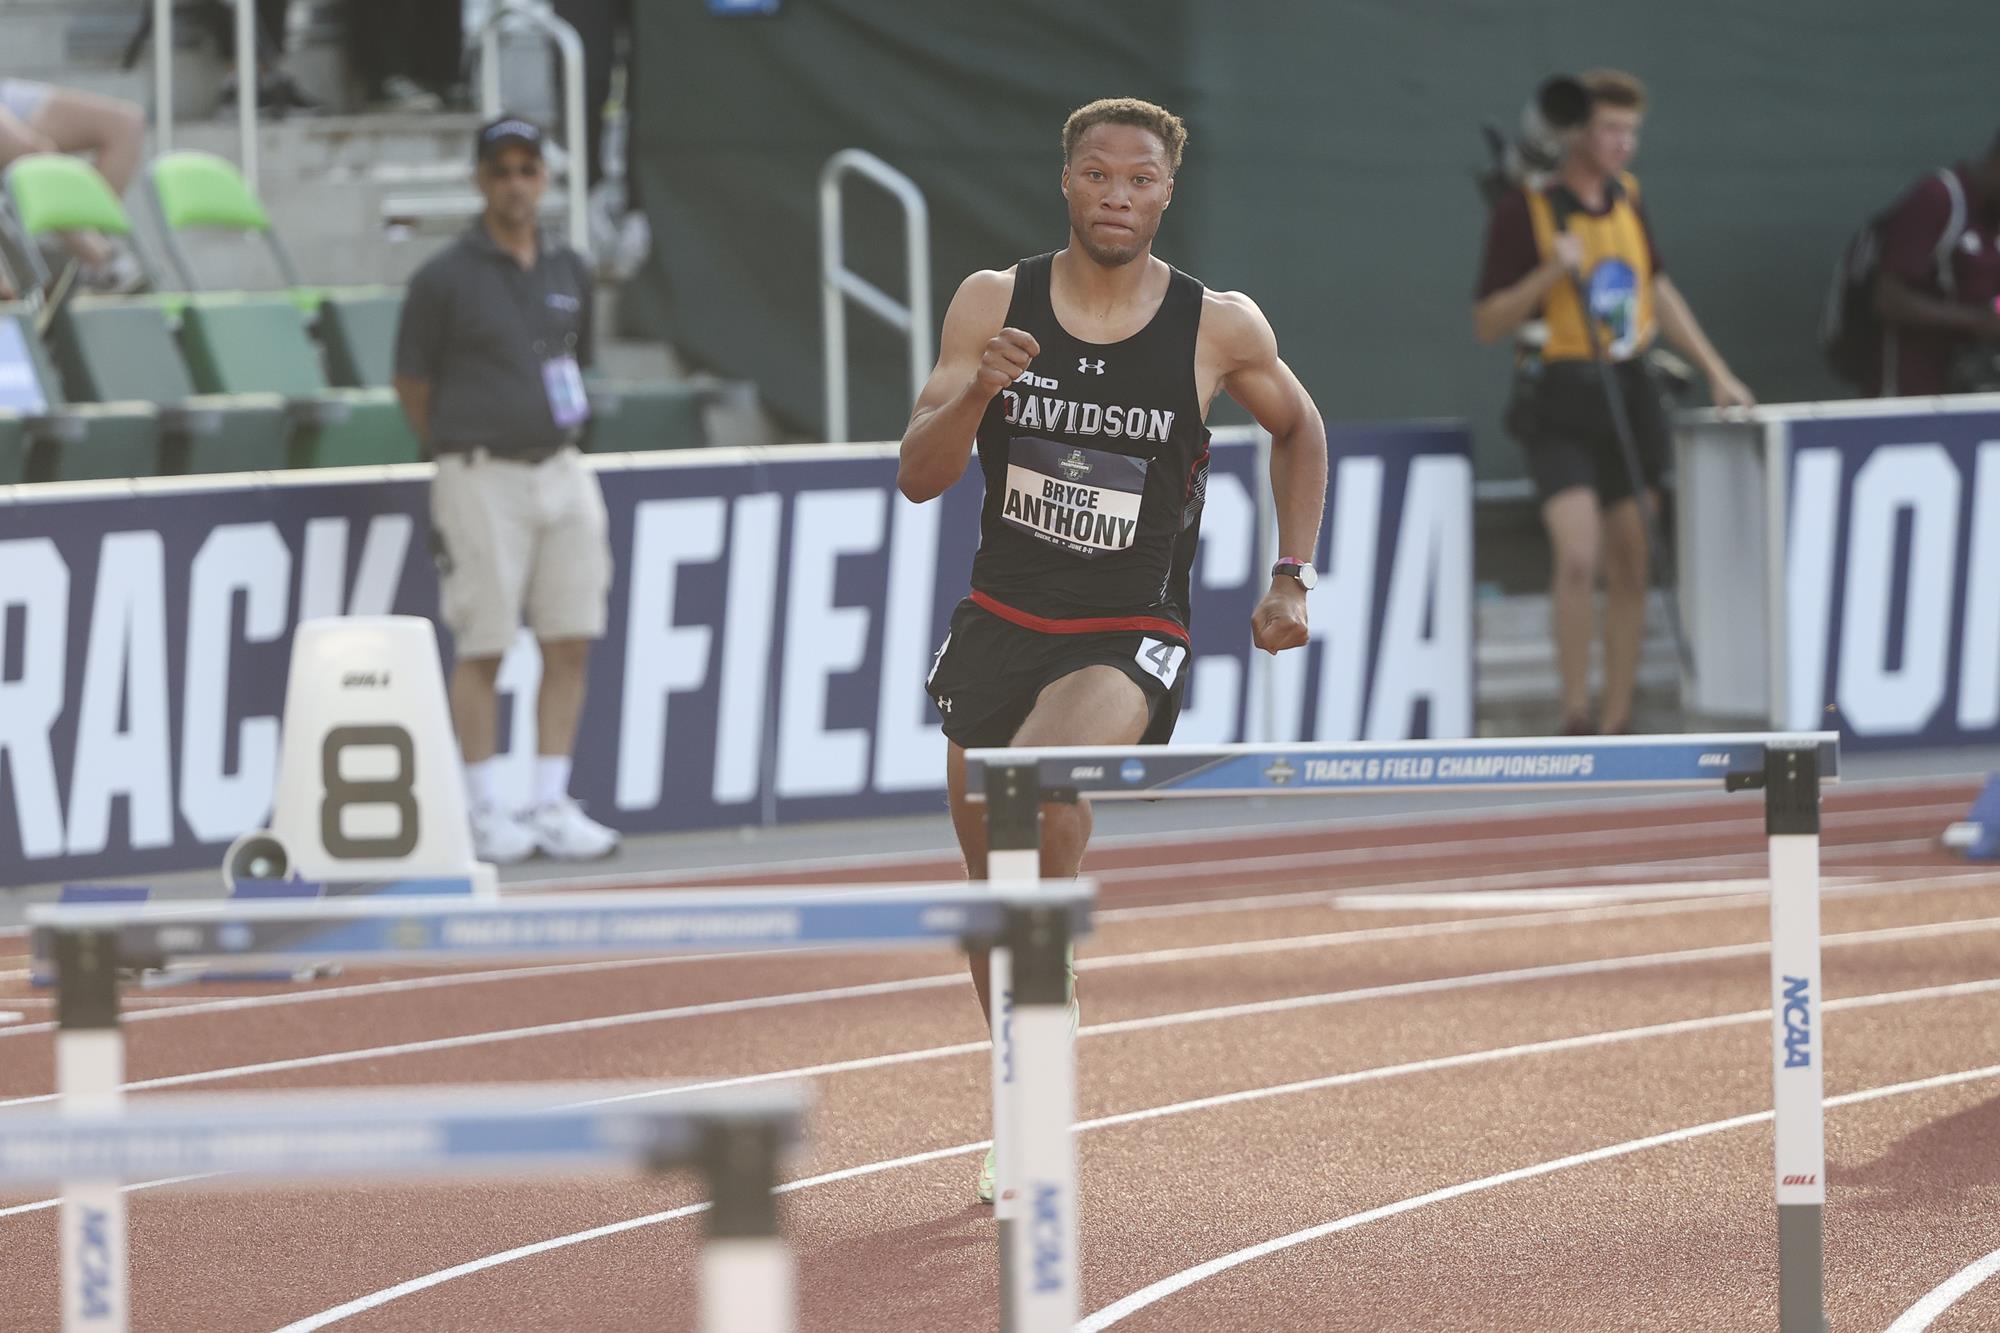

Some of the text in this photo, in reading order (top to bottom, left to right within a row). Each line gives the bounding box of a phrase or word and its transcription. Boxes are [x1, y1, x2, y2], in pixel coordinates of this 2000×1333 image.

[1002, 390, 1175, 443] DAVIDSON
[1004, 488, 1136, 548] ANTHONY
[1042, 479, 1100, 509] BRYCE
[615, 487, 950, 811] FIEL
[1145, 642, 1176, 677] 4
[321, 724, 419, 860] 8
[1304, 760, 1362, 781] TRACK
[1382, 757, 1433, 779] FIELD
[1436, 754, 1595, 778] CHAMPIONSHIPS
[1782, 975, 1811, 1069] NCAA
[1782, 1174, 1817, 1186] GILL
